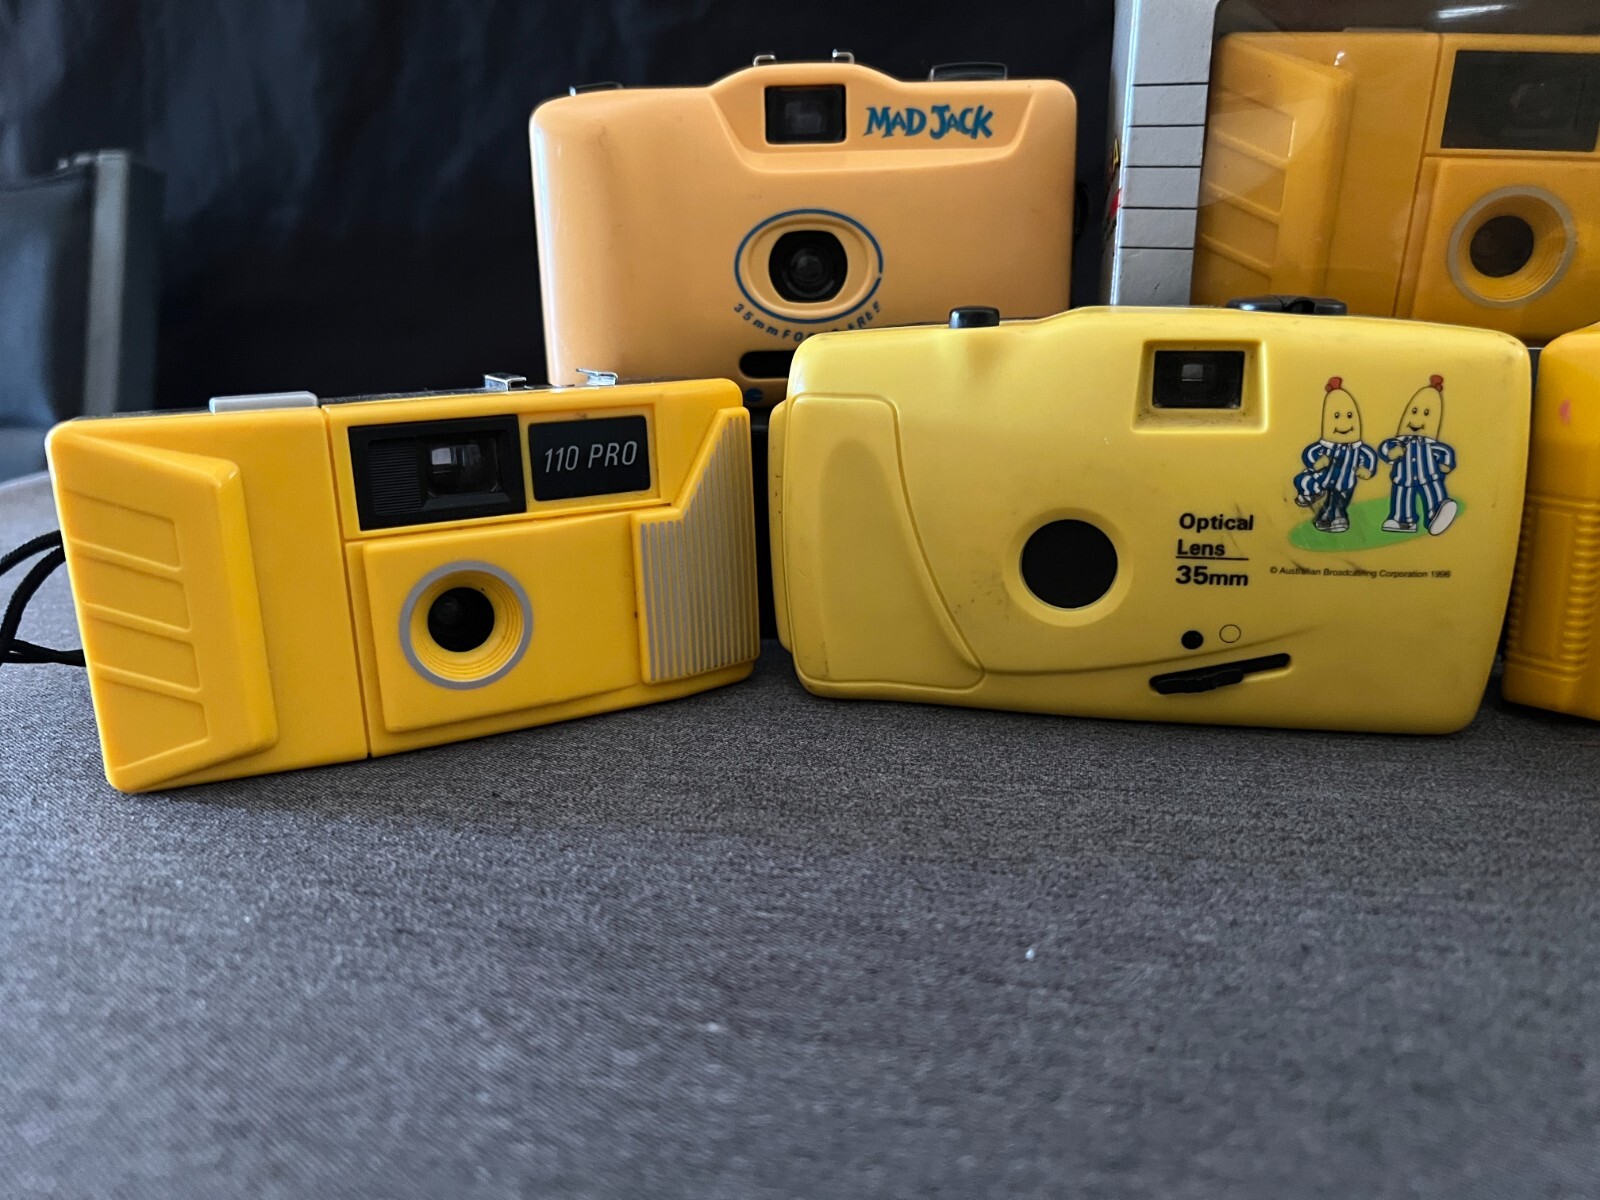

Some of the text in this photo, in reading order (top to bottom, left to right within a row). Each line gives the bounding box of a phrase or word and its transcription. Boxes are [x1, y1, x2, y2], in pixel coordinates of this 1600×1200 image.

[862, 104, 993, 139] MAD JACK
[733, 303, 779, 336] 35mm
[544, 441, 638, 473] 110 PRO
[1179, 512, 1254, 533] Optical
[1177, 538, 1226, 556] Lens
[1175, 565, 1249, 586] 35mm
[1378, 569, 1428, 579] Corporation
